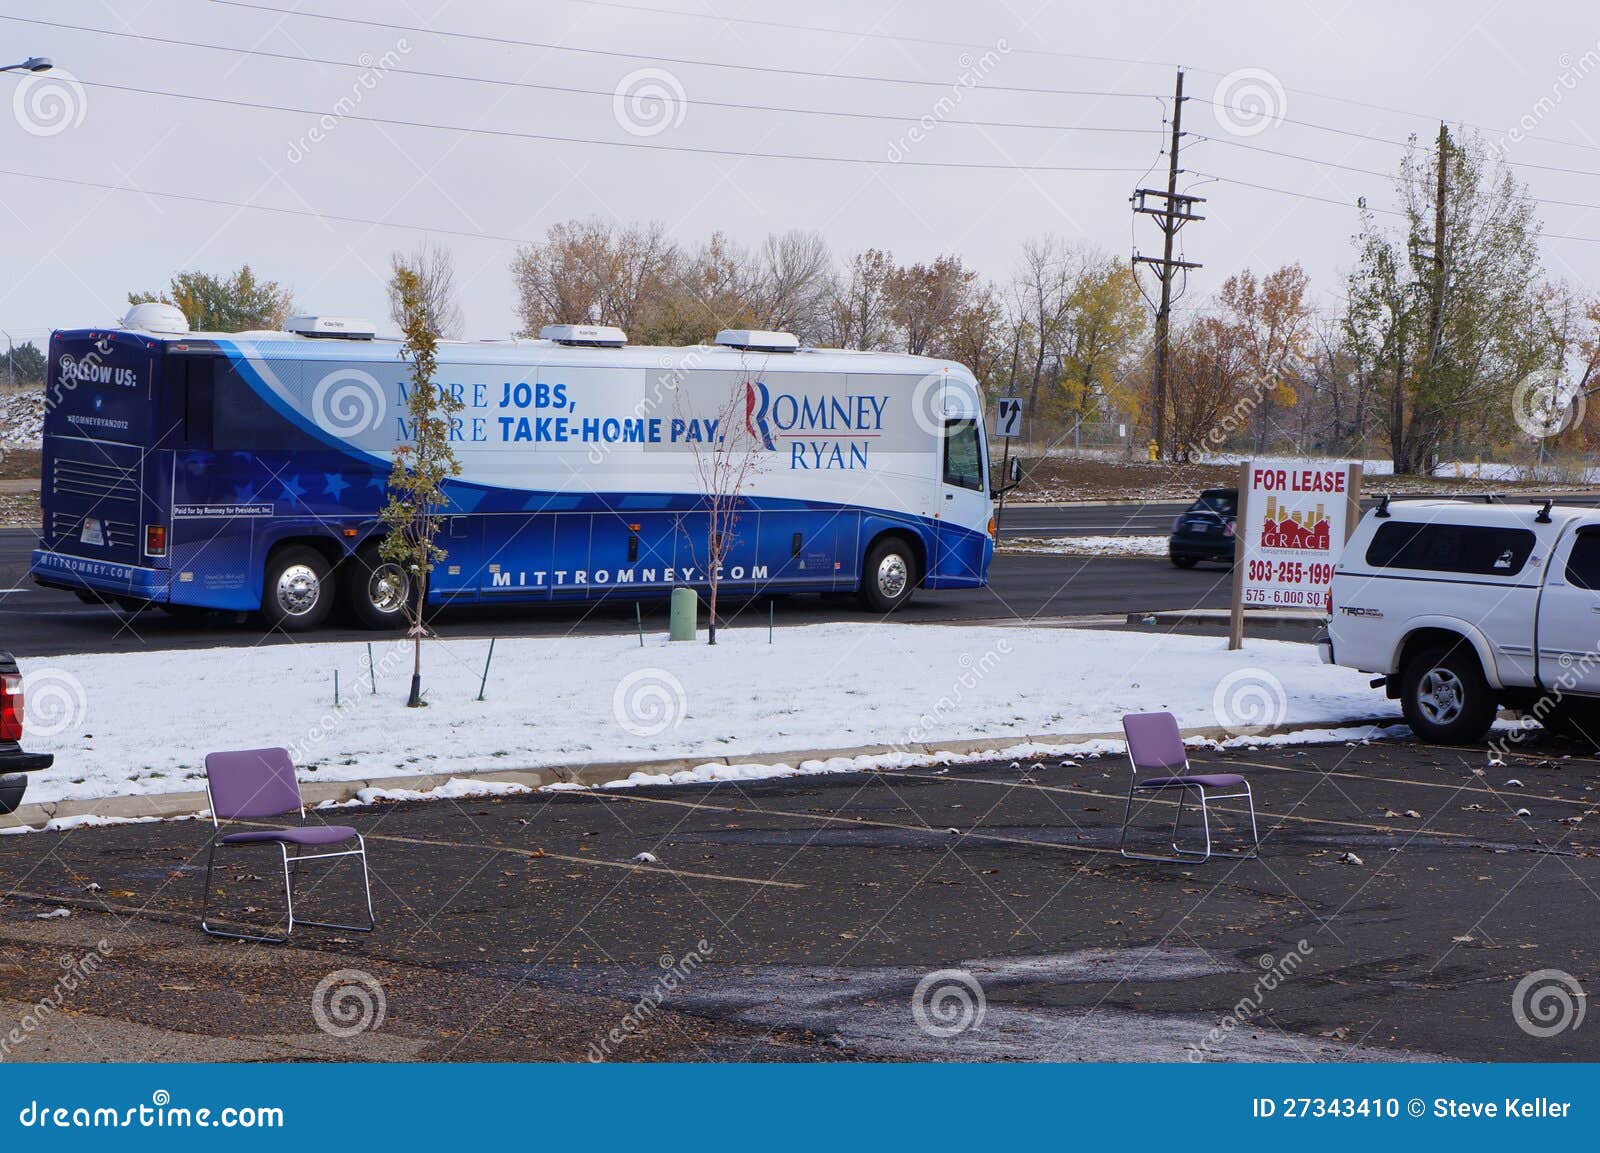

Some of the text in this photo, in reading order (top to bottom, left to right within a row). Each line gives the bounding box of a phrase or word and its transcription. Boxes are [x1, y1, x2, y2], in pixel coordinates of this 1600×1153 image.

[115, 368, 137, 387] US:
[499, 382, 577, 413] JOBS,
[745, 381, 889, 451] ROMNEY
[394, 416, 725, 443] MRE TAKE-HOME PAY.
[790, 441, 871, 470] RYAN
[1253, 469, 1345, 493] FOR LEASE
[1264, 533, 1328, 550] GRACE
[40, 554, 133, 579] MITTROMNEY.COM
[492, 565, 768, 586] MITTROMNEY.COM
[1246, 589, 1265, 602] 575
